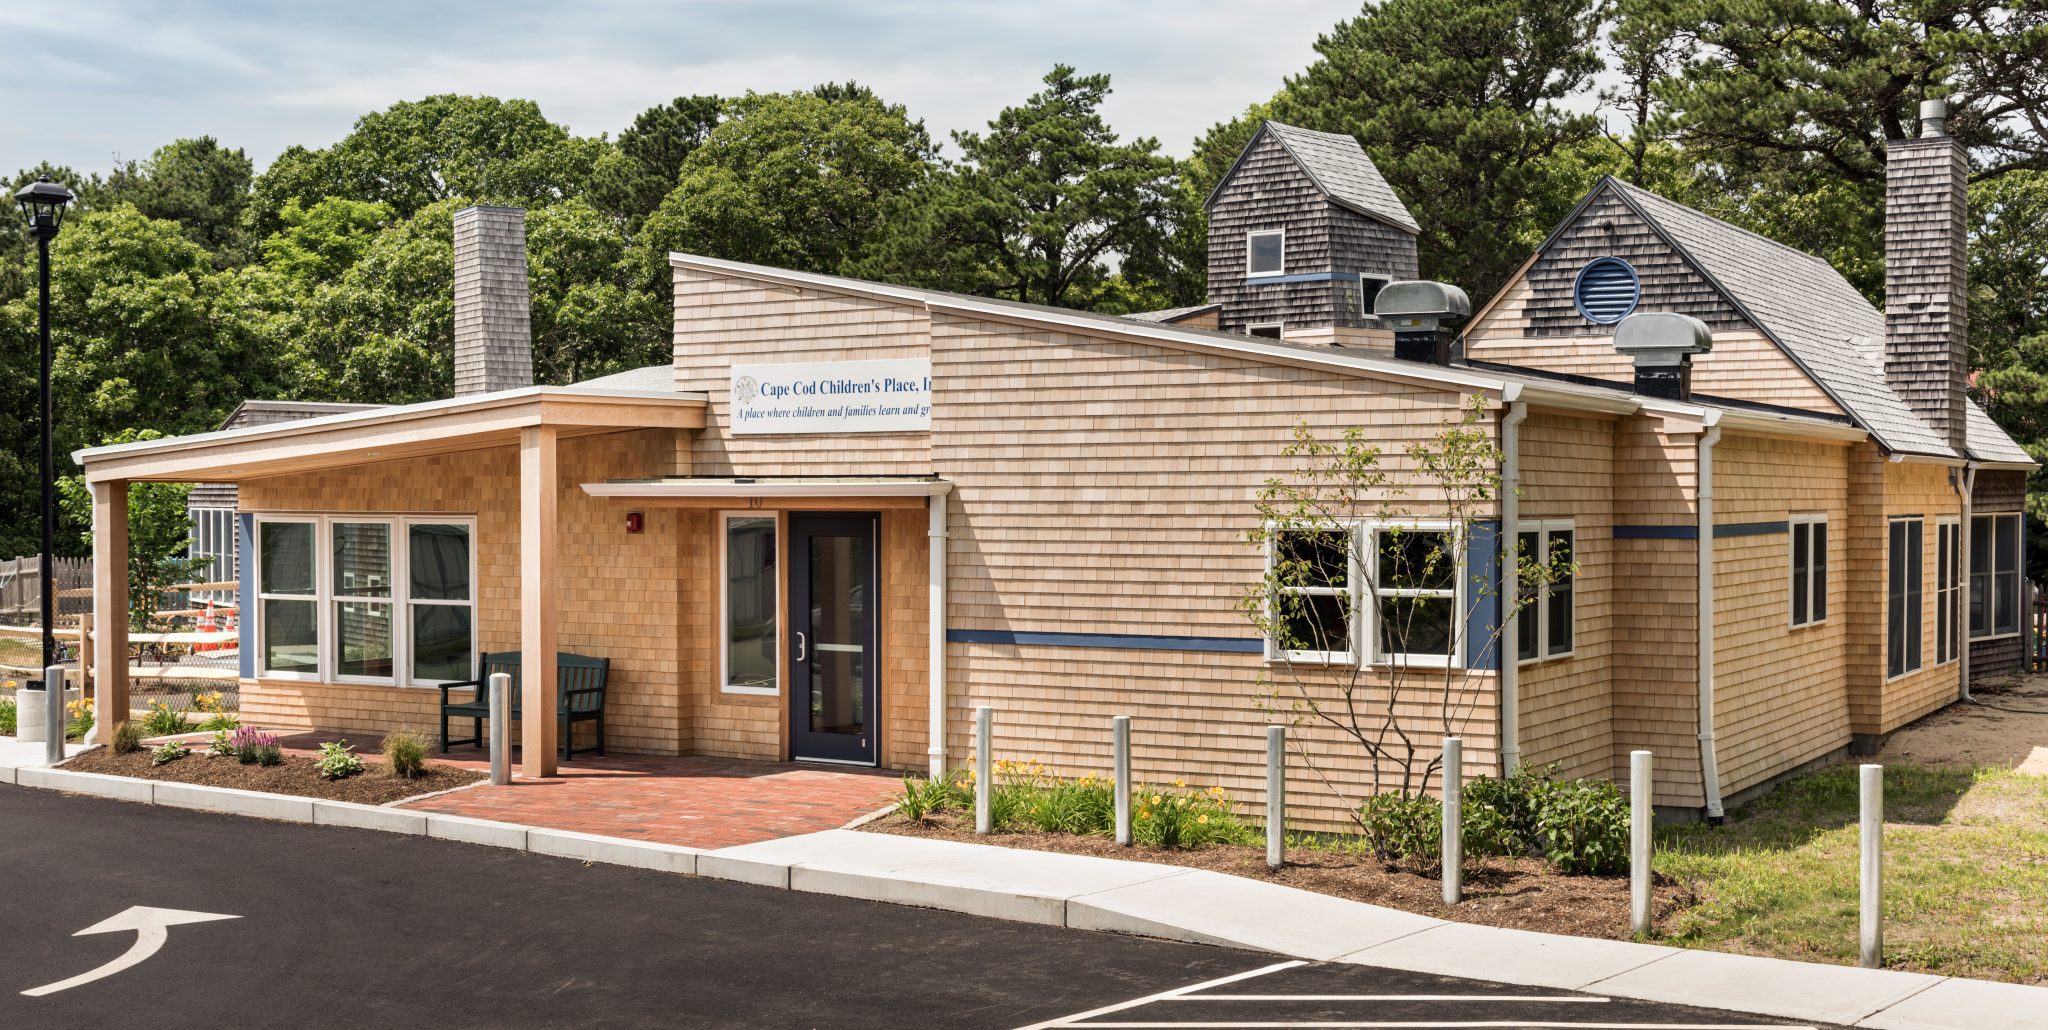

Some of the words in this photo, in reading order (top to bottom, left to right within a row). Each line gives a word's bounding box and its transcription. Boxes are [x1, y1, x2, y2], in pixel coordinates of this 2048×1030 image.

[760, 382, 789, 400] Cape
[793, 380, 816, 395] Cod
[819, 378, 880, 395] Children's
[884, 377, 919, 395] Place,
[736, 408, 743, 419] A
[744, 407, 765, 421] place
[767, 407, 791, 419] where
[792, 406, 825, 418] children
[827, 405, 843, 417] and
[843, 404, 877, 419] families
[878, 403, 900, 416] learn
[902, 403, 919, 415] and
[920, 406, 931, 418] gr
